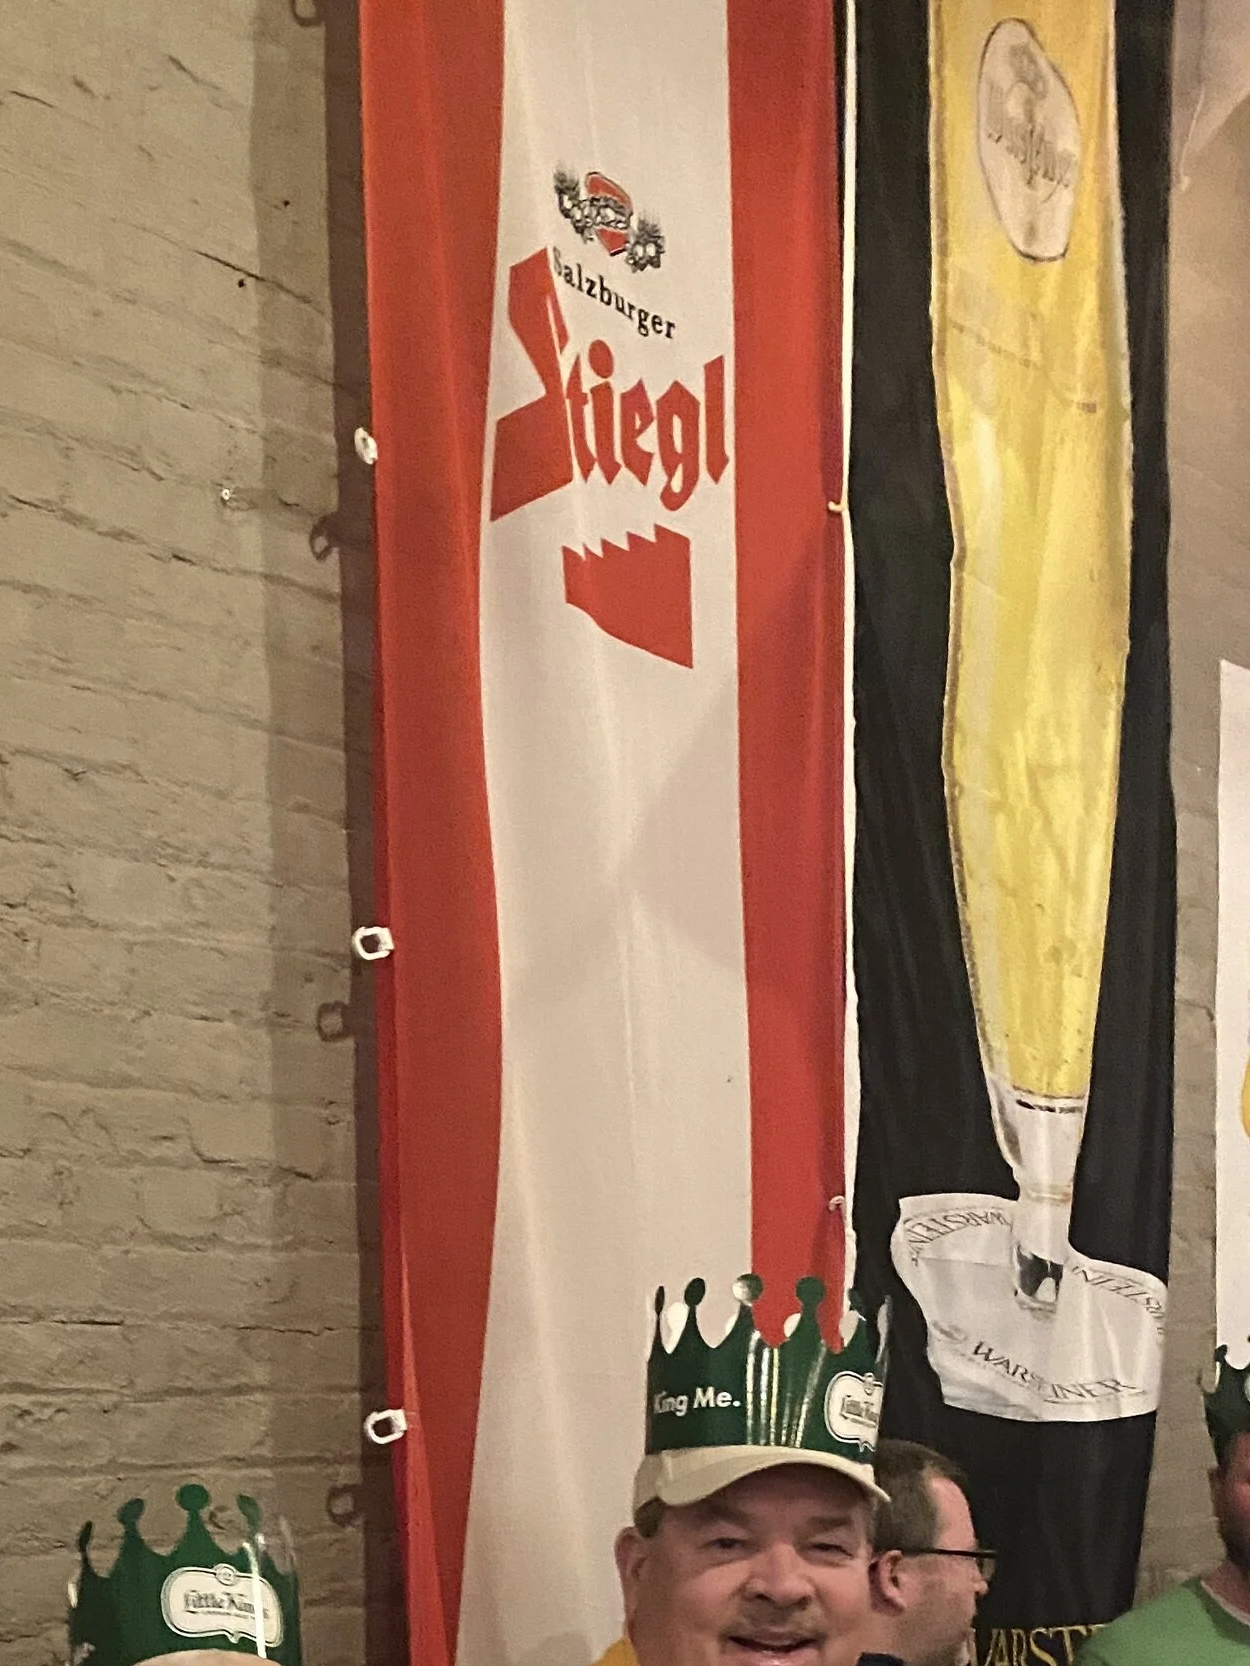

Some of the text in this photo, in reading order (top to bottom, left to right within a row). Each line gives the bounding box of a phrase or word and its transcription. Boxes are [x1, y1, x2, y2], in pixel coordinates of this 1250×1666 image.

[552, 244, 676, 340] Salzburger
[489, 246, 730, 522] Stiegl
[692, 1386, 742, 1409] Me.
